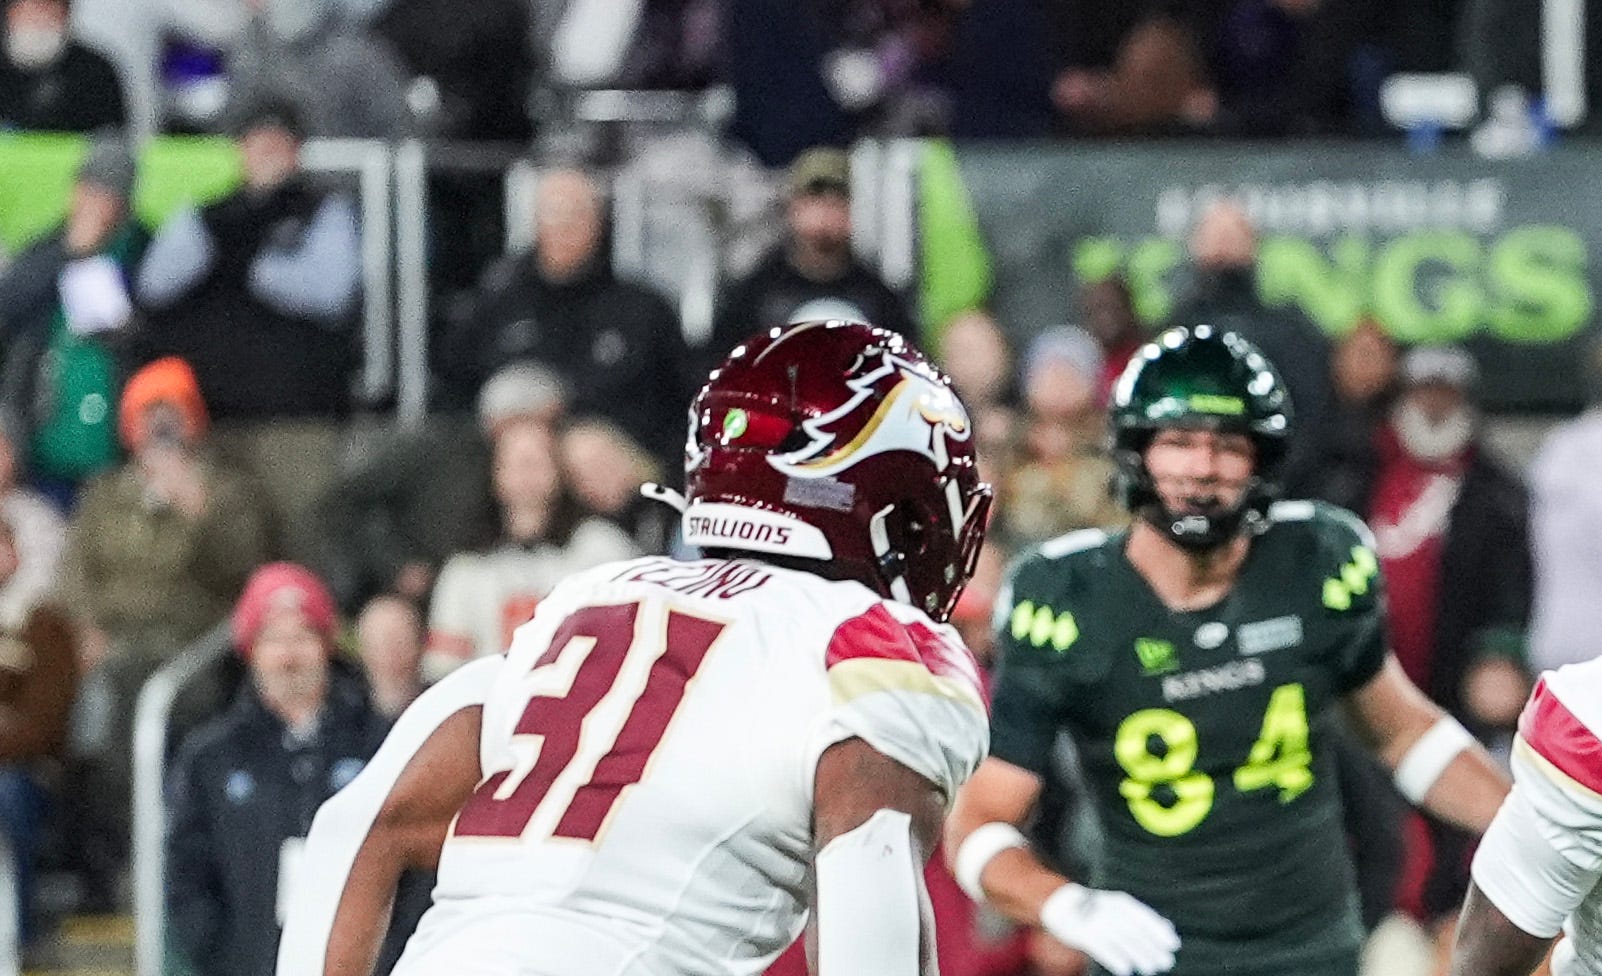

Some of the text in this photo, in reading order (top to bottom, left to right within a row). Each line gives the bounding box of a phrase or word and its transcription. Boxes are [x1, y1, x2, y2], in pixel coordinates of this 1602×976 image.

[1072, 226, 1593, 346] KNGS
[689, 516, 792, 545] STALLIONS
[454, 601, 726, 841] 31
[1115, 682, 1314, 838] 84
